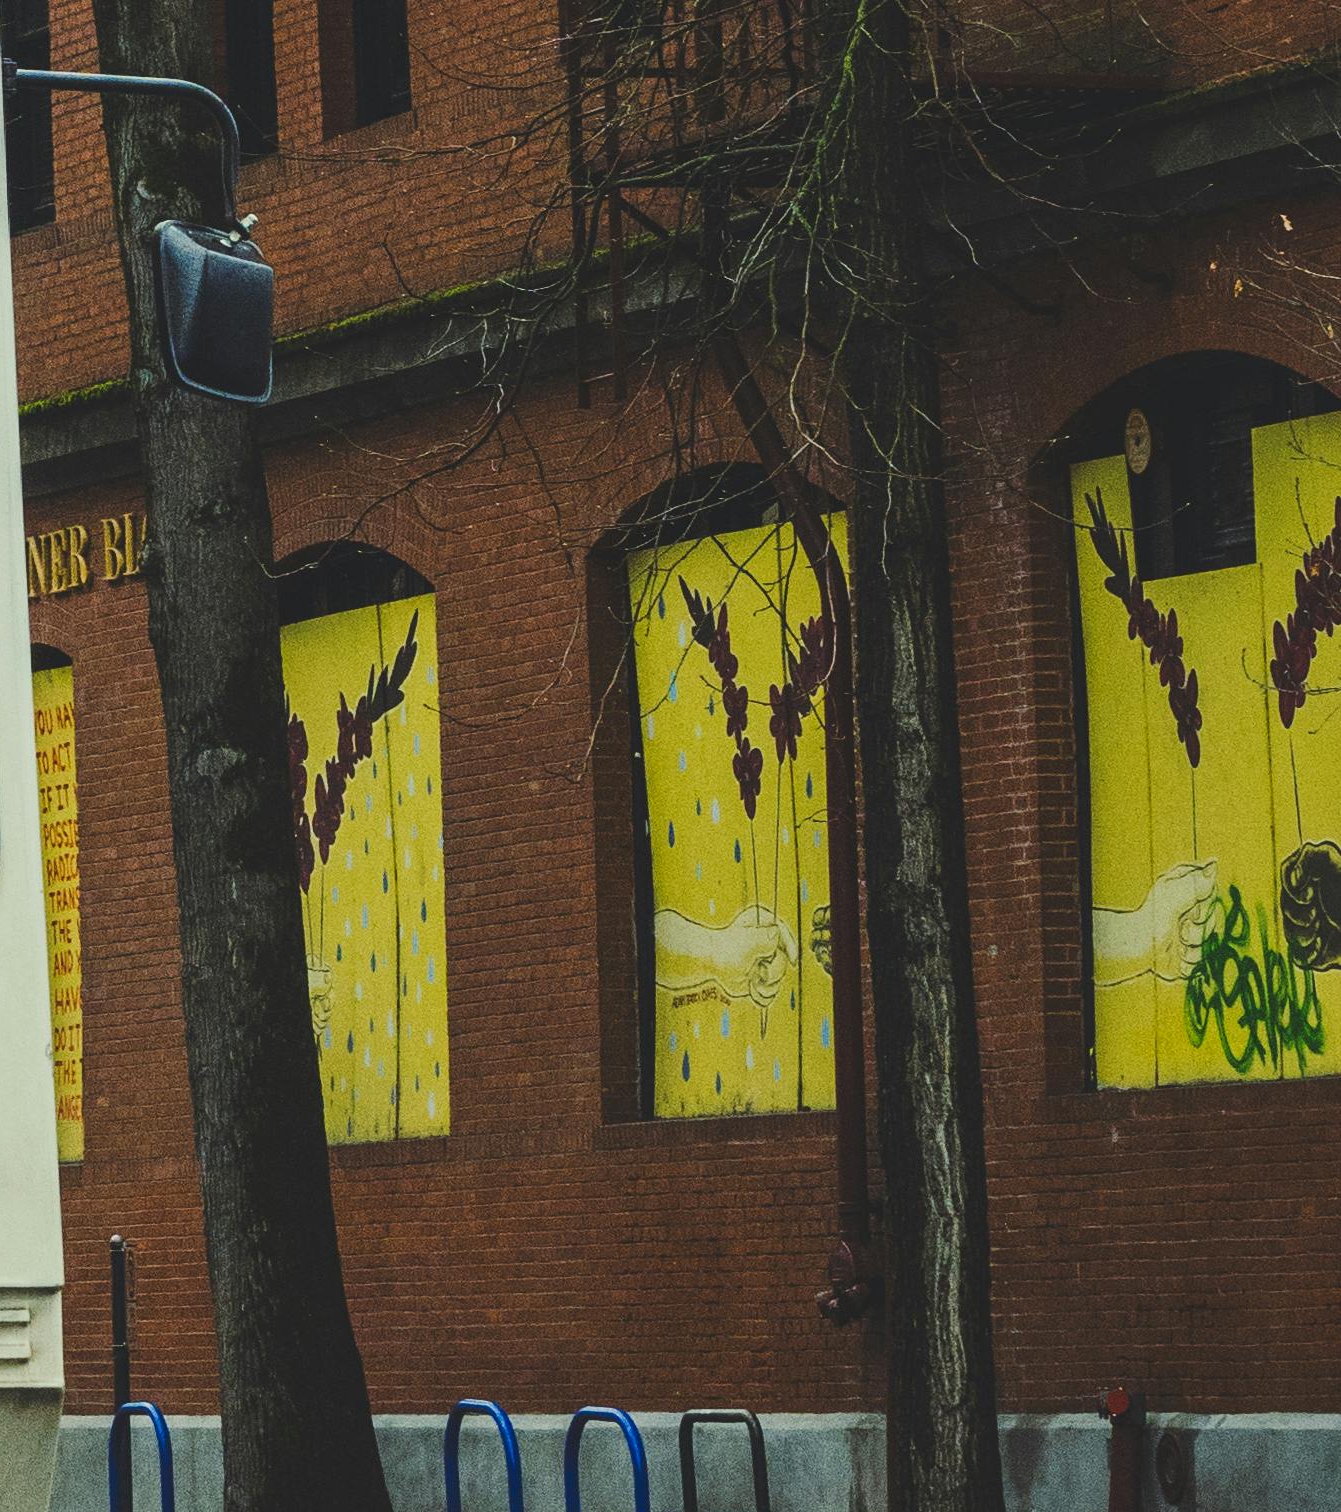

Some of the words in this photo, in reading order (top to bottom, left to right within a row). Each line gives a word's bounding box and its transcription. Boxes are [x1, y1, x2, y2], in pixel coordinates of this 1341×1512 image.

[36, 751, 49, 776] TO
[52, 742, 71, 773] ACT
[40, 786, 52, 814] IF
[55, 783, 69, 811] IT
[46, 853, 79, 887] RADIC
[51, 919, 72, 946] THE
[53, 949, 73, 978] AND
[54, 1027, 66, 1052] DO
[68, 1023, 80, 1052] IT
[54, 1059, 77, 1087] THE
